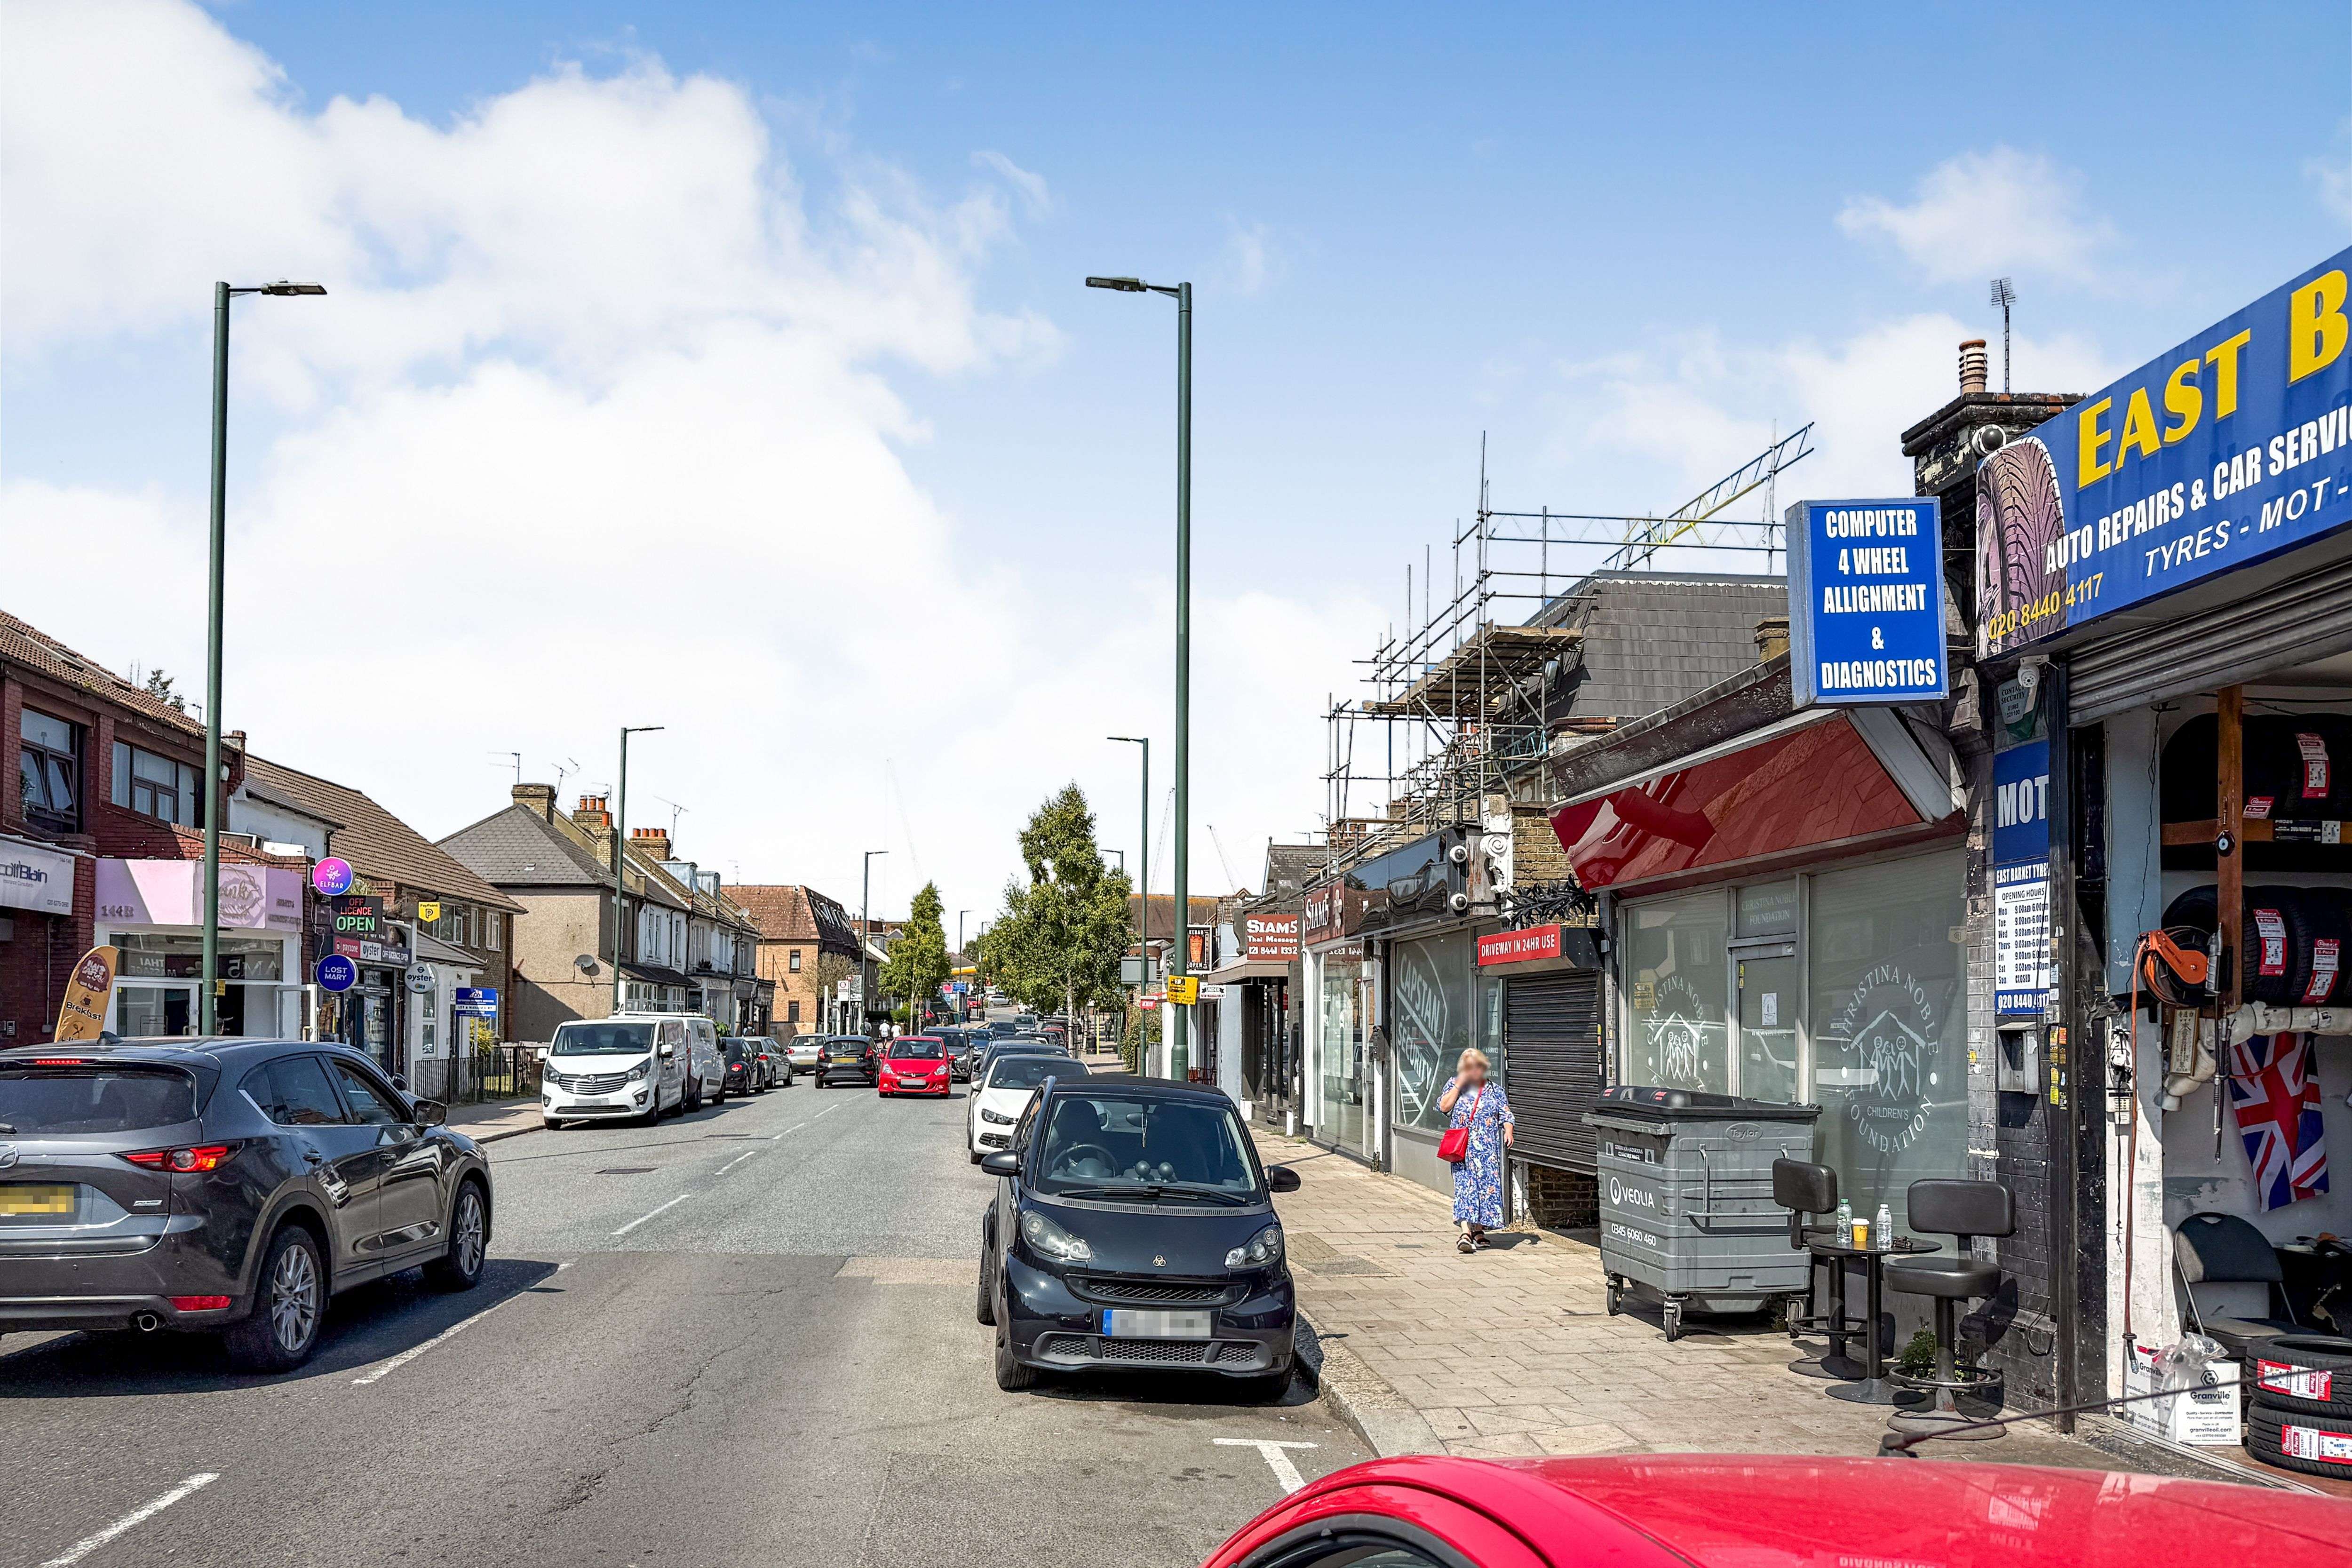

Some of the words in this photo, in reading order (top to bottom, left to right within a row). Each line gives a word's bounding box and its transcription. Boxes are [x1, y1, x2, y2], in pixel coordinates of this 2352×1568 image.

[2077, 328, 2251, 490] EAST
[2288, 269, 2349, 385] B
[2045, 527, 2092, 575] AUTO
[2098, 481, 2185, 552] REPAIRS
[2191, 482, 2207, 512] &
[2213, 446, 2262, 501] CAR
[1826, 509, 1917, 538] COMPUTER
[2144, 520, 2230, 578] TYRES
[2259, 476, 2331, 534] MOT
[1838, 549, 1850, 575] 4
[1853, 547, 1909, 575] WHEEL
[1824, 584, 1926, 613] ALLIGNMENT
[1988, 612, 2016, 640] 020
[2021, 590, 2060, 626] 8440
[2066, 572, 2104, 607] 4117
[1871, 627, 1884, 650] &
[1821, 659, 1936, 689] DIAGNOSTICS
[2001, 692, 2025, 705] SECURITY
[1998, 774, 2049, 828] MOT
[1996, 868, 2010, 884] EAST
[2010, 865, 2032, 882] BARNET
[1741, 896, 1775, 911] CHRISTINA
[1775, 891, 1796, 905] NOBLE
[2002, 890, 2025, 900] OPENING
[2026, 887, 2045, 897] HOURS
[340, 907, 372, 915] LICENCE
[1749, 909, 1790, 926] FOUNDATION
[336, 916, 375, 931] OPEN
[1998, 930, 2008, 939] Wed
[342, 943, 358, 955] payzone
[362, 944, 380, 958] oyster
[1281, 946, 1298, 955] 1332
[1481, 940, 1512, 957] DRIVEWAY
[1514, 940, 1520, 953] IN
[1522, 936, 1540, 952] 24HR
[1542, 934, 1555, 949] USE
[407, 973, 432, 982] oyster
[2015, 974, 2031, 983] CLOSED
[1400, 952, 1440, 1038] CAPSTAN
[1998, 995, 2012, 1009] 020
[2013, 994, 2032, 1009] 8440
[1647, 975, 1684, 1045] CHRISTINA
[1686, 982, 1708, 1047] NOBLE
[1840, 965, 1899, 1052] CHRISTINA
[1904, 972, 1939, 1056] NOBLE
[1398, 1021, 1432, 1092] SECURITY
[1844, 1088, 1934, 1153] FOUNDATION
[1867, 1106, 1909, 1120] CHILDREN'S
[1731, 1128, 1759, 1139] Taylor
[1621, 1186, 1655, 1209] VEOLIA
[1611, 1223, 1626, 1236] 0345
[1627, 1228, 1642, 1242] 6060
[1644, 1234, 1656, 1246] 460
[2139, 1362, 2164, 1377] Granville
[2190, 1391, 2230, 1399] Granville
